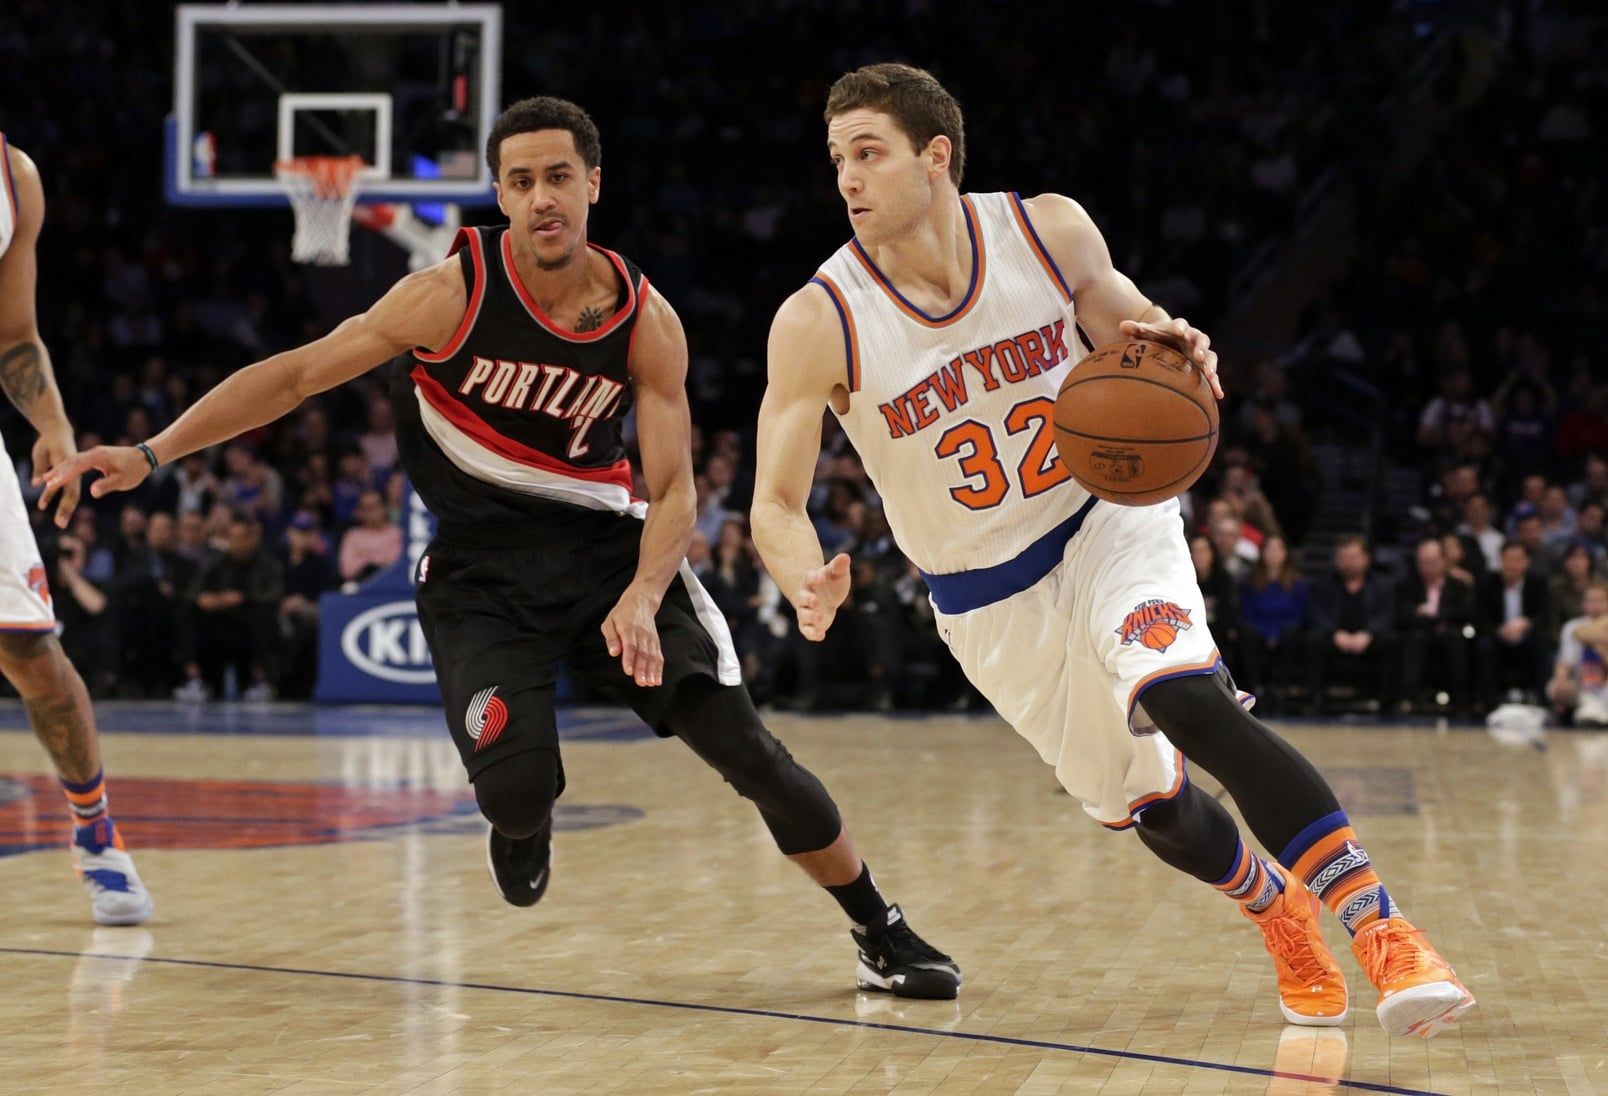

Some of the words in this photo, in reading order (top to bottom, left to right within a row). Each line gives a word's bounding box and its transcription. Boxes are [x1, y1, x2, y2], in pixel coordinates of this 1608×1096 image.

[458, 355, 624, 419] PORTLAN
[878, 354, 968, 439] NEW
[965, 319, 1069, 392] YORK
[567, 414, 590, 459] 2
[935, 396, 1073, 511] 32
[369, 617, 433, 666] KI
[1120, 602, 1192, 645] KNICKS
